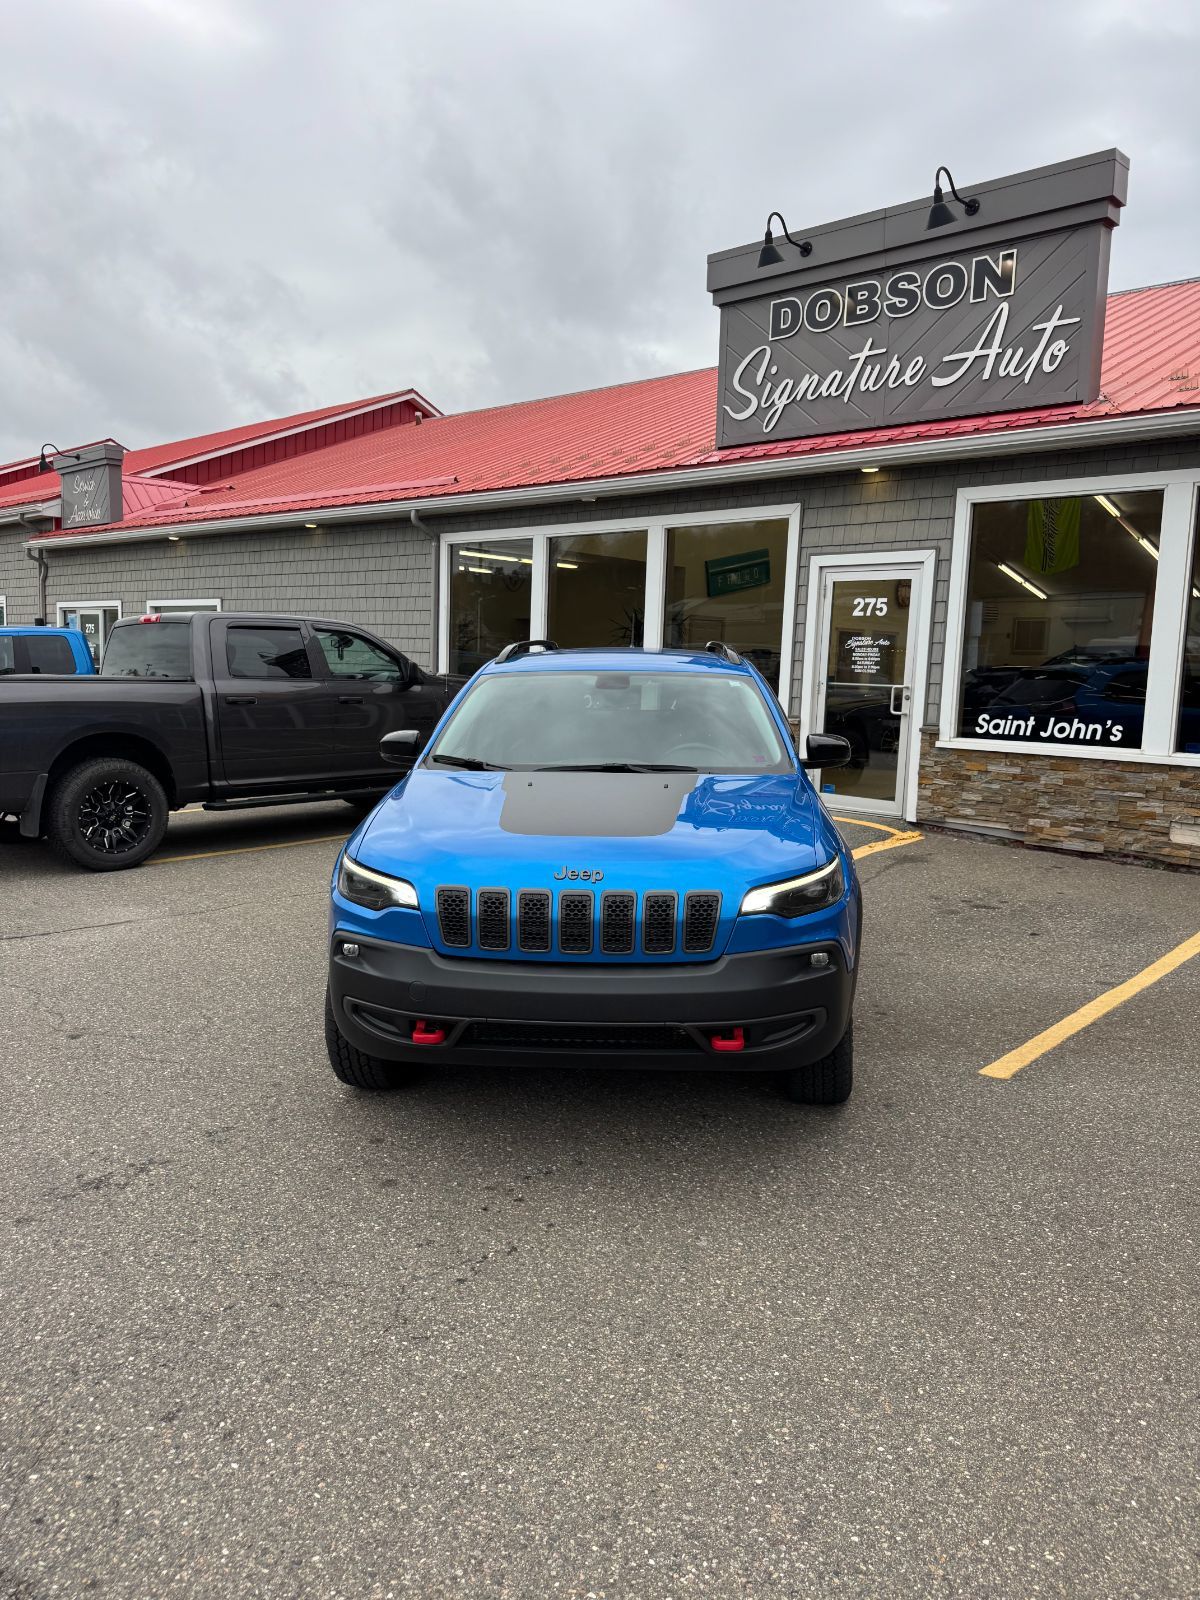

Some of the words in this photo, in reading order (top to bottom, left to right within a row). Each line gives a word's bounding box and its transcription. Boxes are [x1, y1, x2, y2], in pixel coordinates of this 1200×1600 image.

[769, 249, 1018, 341] DOBSON
[722, 337, 927, 433] Signature
[931, 301, 1081, 387] Auto
[852, 597, 888, 617] 275
[85, 623, 95, 634] 275
[975, 713, 1036, 737] Saint
[1040, 717, 1124, 742] John's
[553, 865, 605, 884] Jeep
